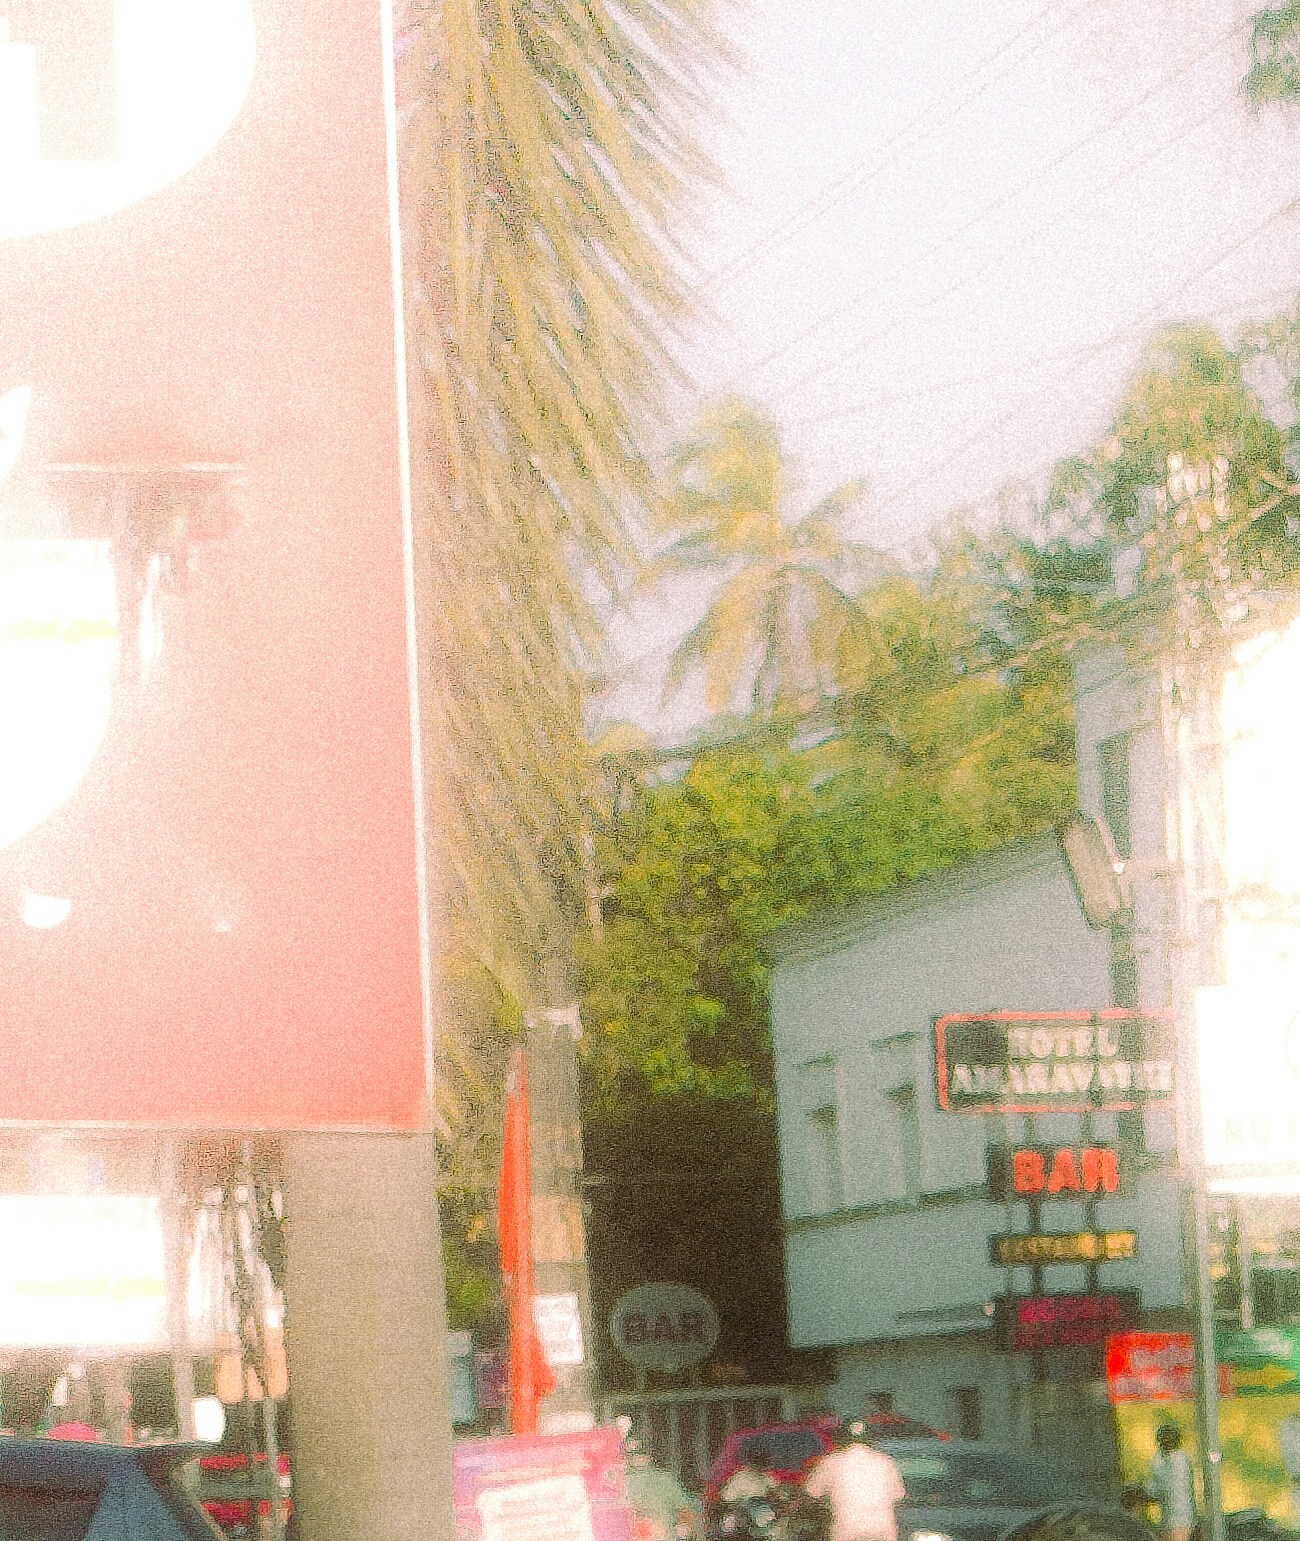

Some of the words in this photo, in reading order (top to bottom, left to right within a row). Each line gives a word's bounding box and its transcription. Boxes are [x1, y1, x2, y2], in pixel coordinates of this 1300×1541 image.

[1221, 1113, 1273, 1149] NO
[1012, 1148, 1119, 1194] BAR
[623, 1306, 707, 1345] BAR
